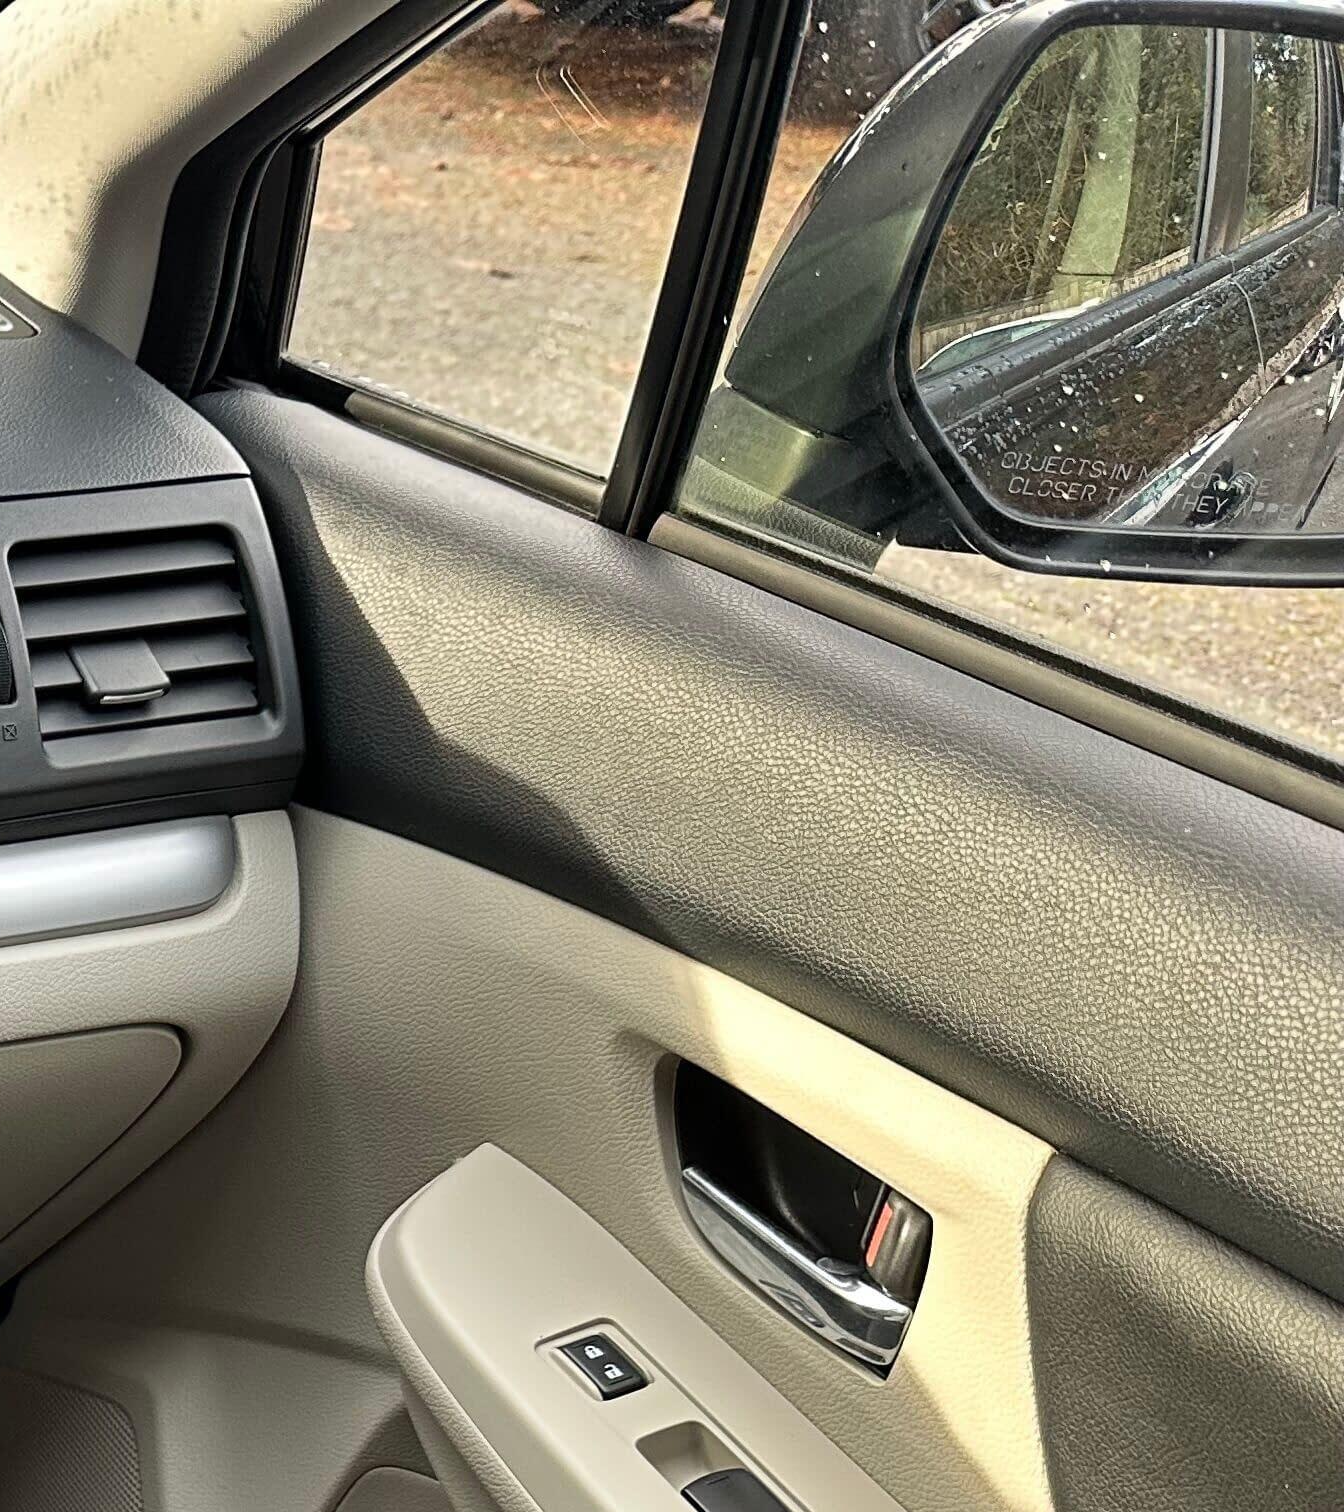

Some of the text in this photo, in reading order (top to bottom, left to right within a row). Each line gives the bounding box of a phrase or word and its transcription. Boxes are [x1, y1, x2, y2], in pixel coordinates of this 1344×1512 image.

[1001, 451, 1105, 478] OBJECTS
[1109, 463, 1133, 481] IN
[1008, 476, 1097, 502] CLOSER
[1172, 493, 1229, 514] THEY
